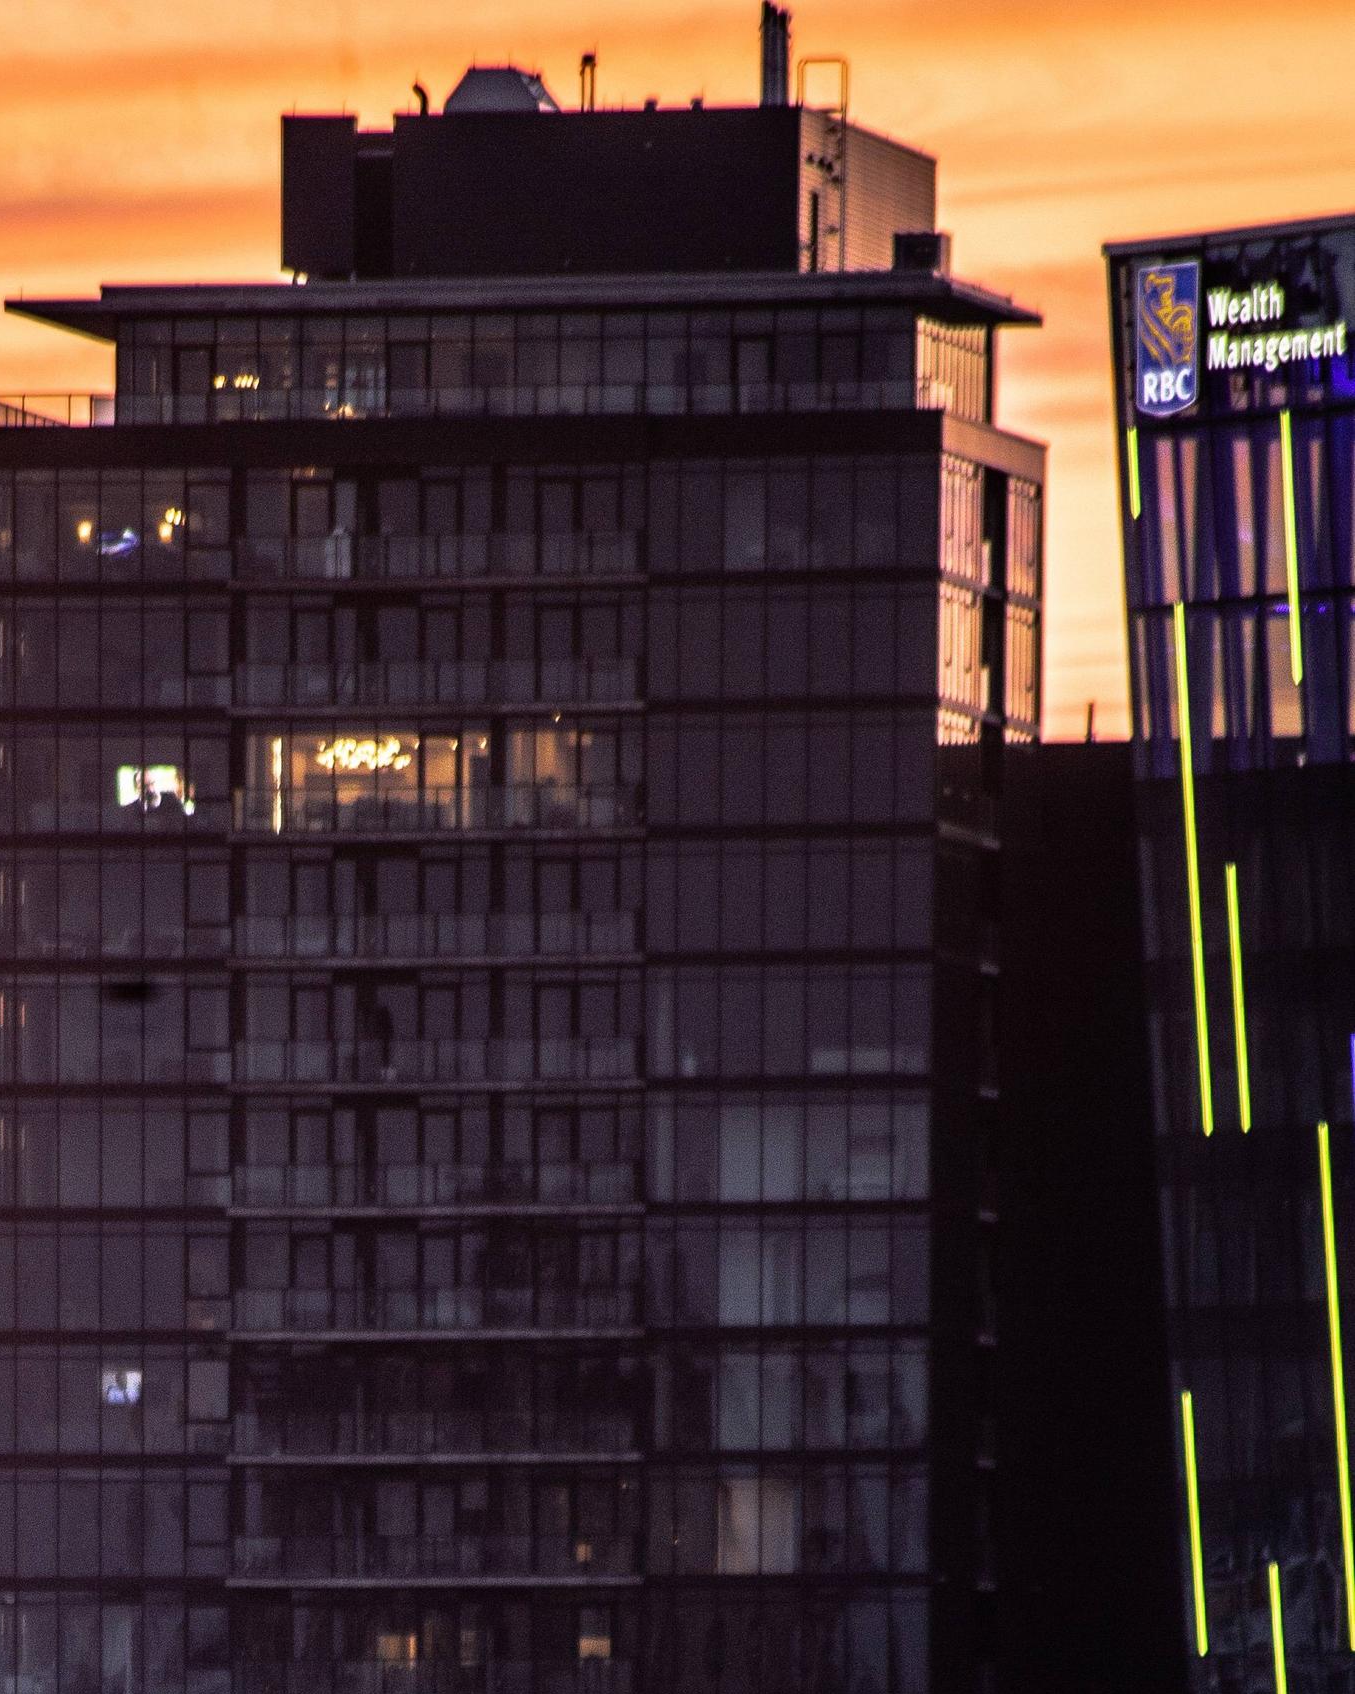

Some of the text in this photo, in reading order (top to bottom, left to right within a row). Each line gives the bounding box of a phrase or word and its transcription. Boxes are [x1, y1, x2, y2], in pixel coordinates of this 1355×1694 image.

[1207, 282, 1285, 327] Wealth
[1207, 321, 1346, 372] Management
[1143, 367, 1193, 405] RBC
